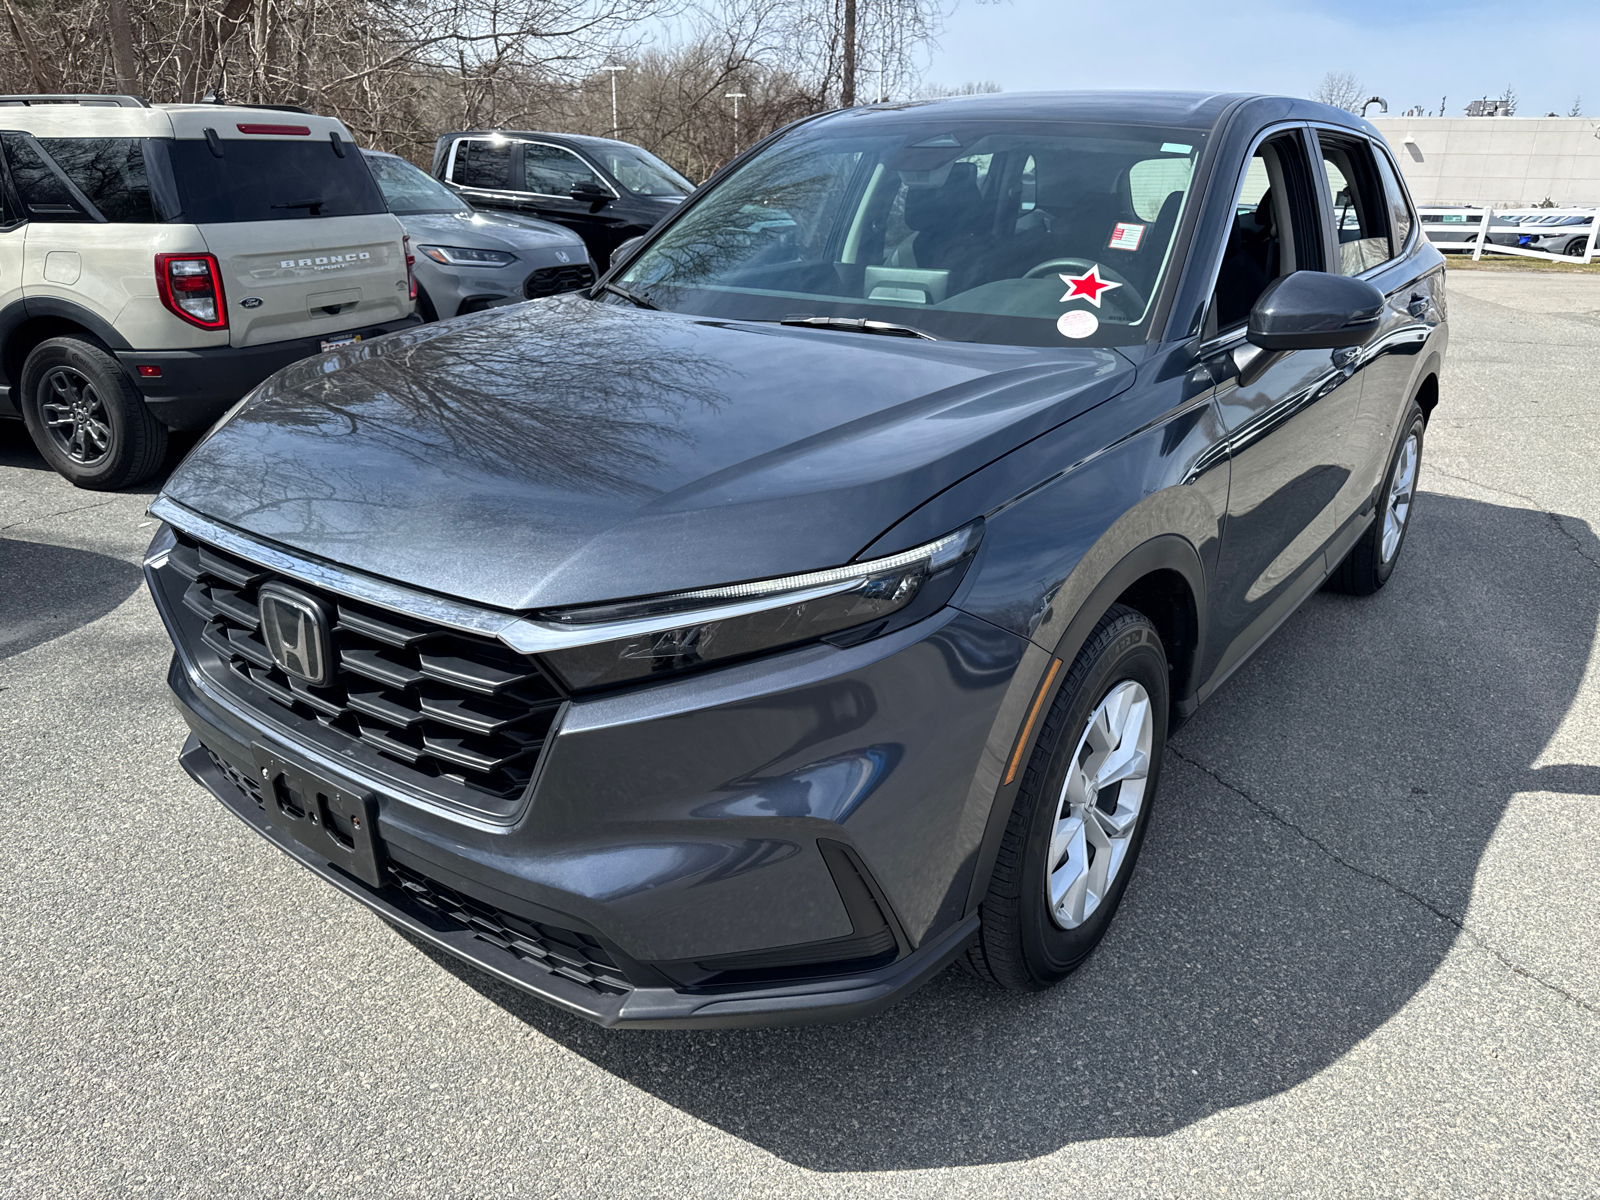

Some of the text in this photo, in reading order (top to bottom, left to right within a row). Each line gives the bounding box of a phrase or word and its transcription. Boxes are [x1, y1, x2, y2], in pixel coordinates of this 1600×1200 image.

[280, 252, 370, 268] BRONCO
[314, 263, 346, 271] SPORT
[72, 352, 107, 388] Continen
